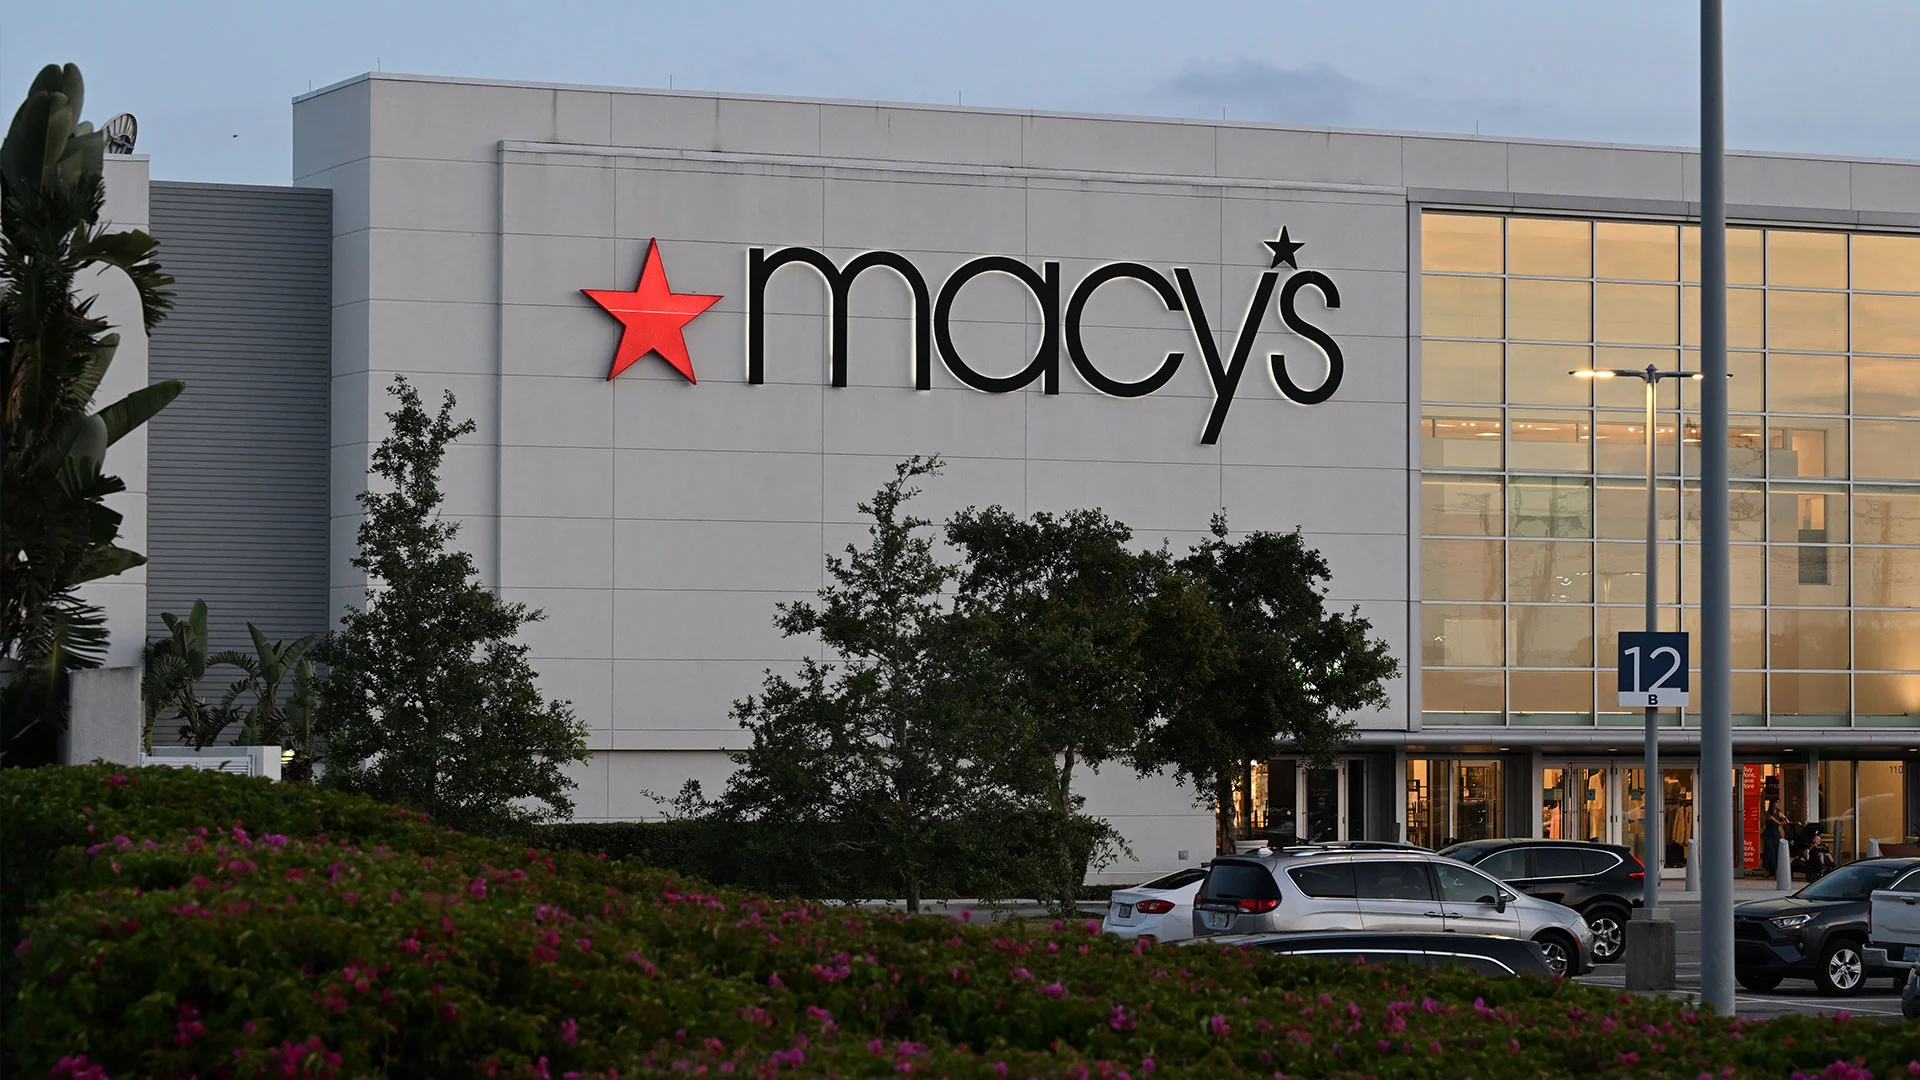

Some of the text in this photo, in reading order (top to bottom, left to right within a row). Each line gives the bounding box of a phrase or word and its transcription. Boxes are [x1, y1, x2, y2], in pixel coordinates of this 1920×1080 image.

[748, 225, 1344, 445] macy's
[1624, 646, 1681, 693] 12
[1648, 694, 1658, 705] B
